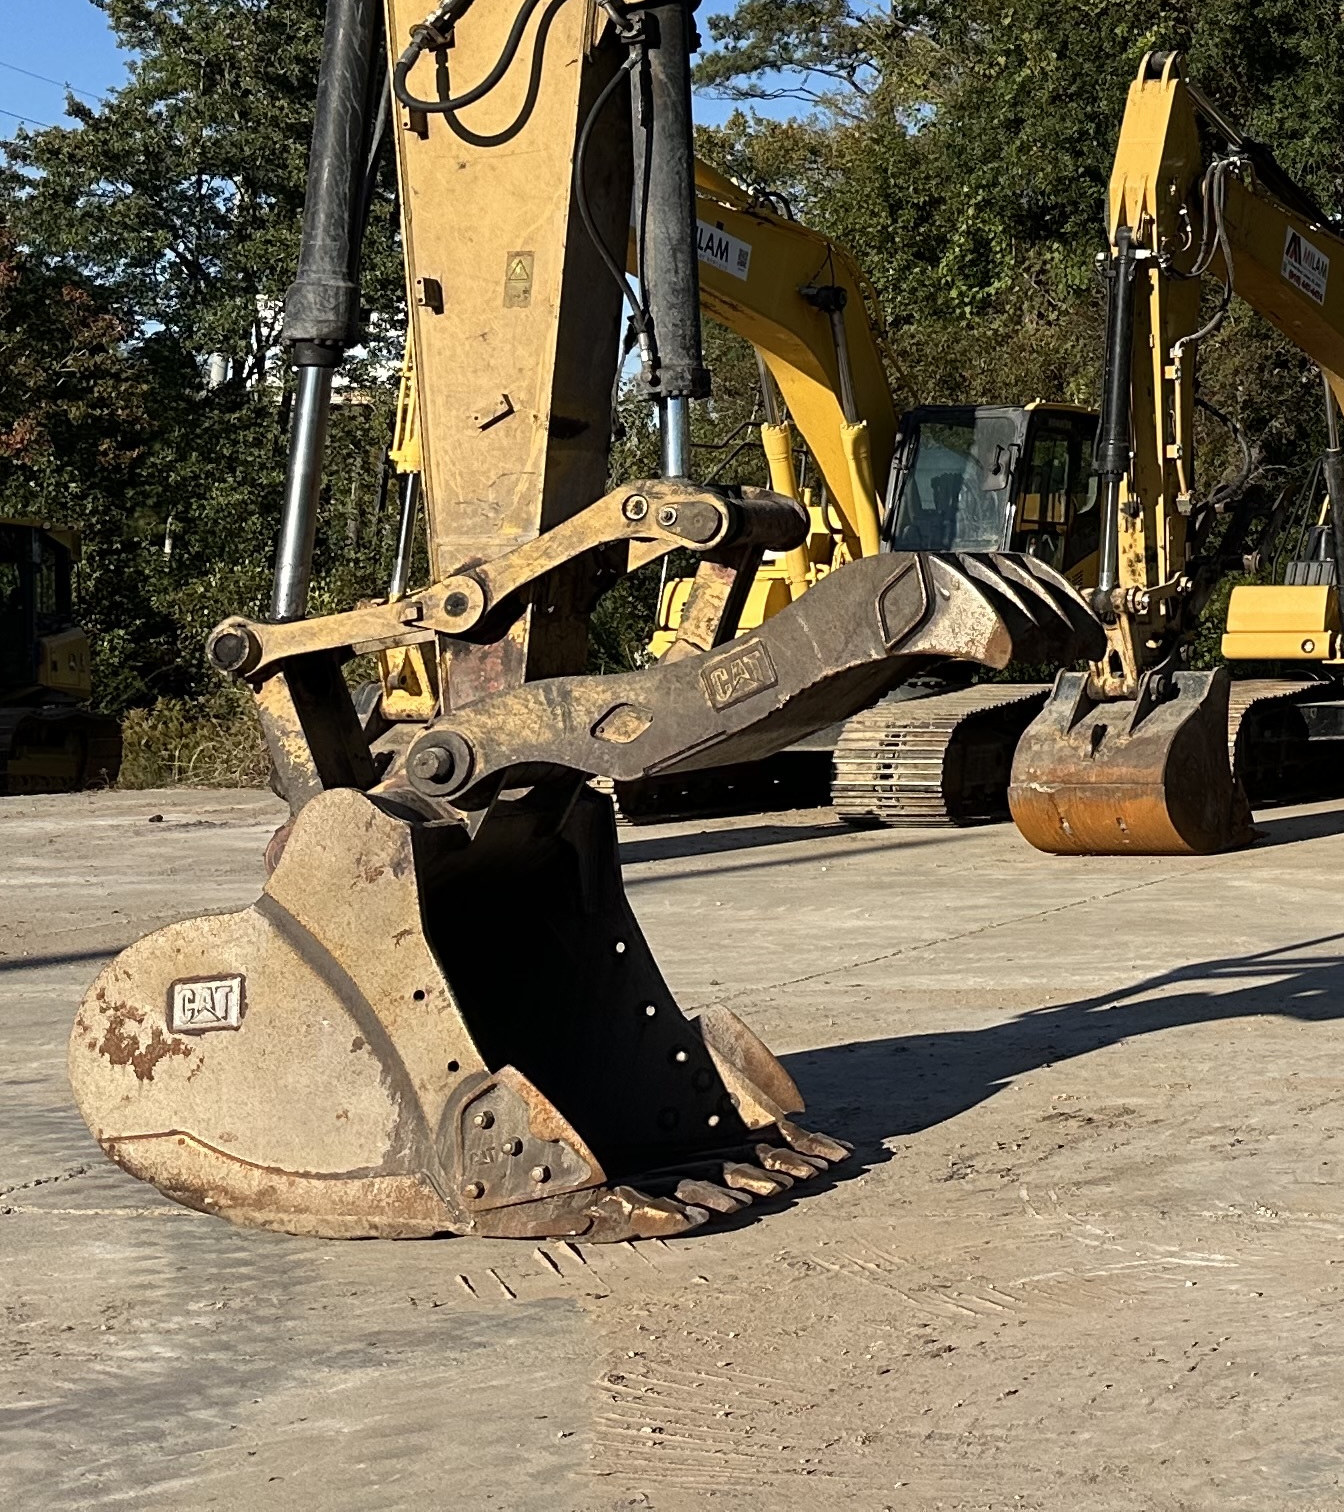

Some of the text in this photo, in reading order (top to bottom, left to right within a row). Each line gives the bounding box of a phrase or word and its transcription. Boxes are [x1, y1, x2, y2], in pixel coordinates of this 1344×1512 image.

[697, 227, 729, 263] LAM
[710, 649, 765, 701] CAT
[180, 984, 235, 1025] CAT
